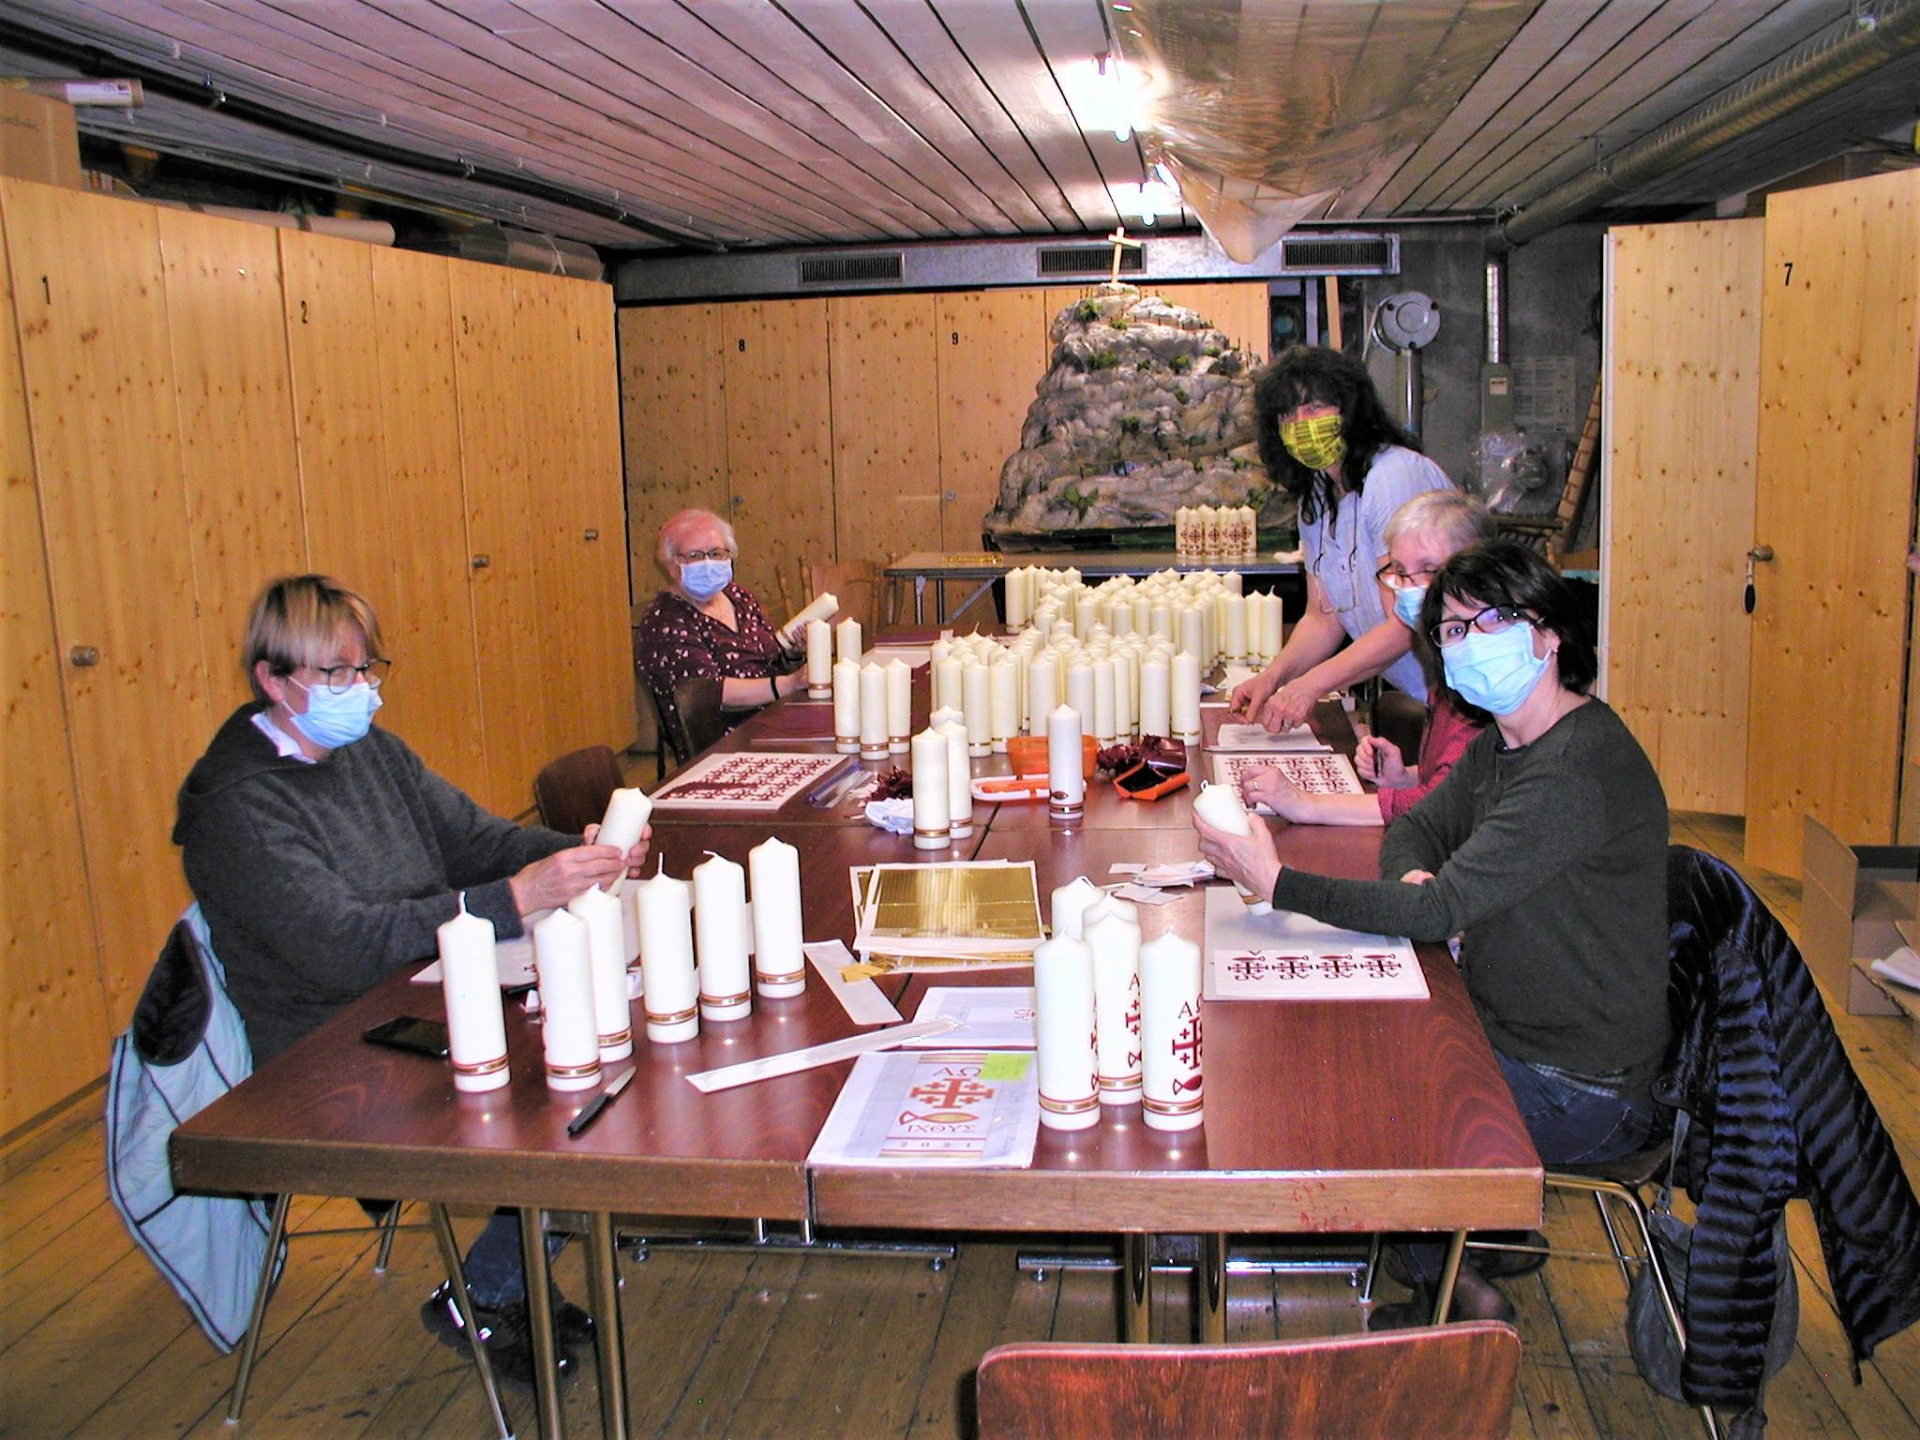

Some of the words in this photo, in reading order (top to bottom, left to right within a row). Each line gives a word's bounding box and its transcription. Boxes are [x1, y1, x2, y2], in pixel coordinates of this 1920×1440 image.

[1784, 262, 1794, 287] 7
[42, 275, 51, 305] 1
[300, 300, 308, 324] 2
[738, 339, 746, 352] 8
[951, 332, 959, 345] 9
